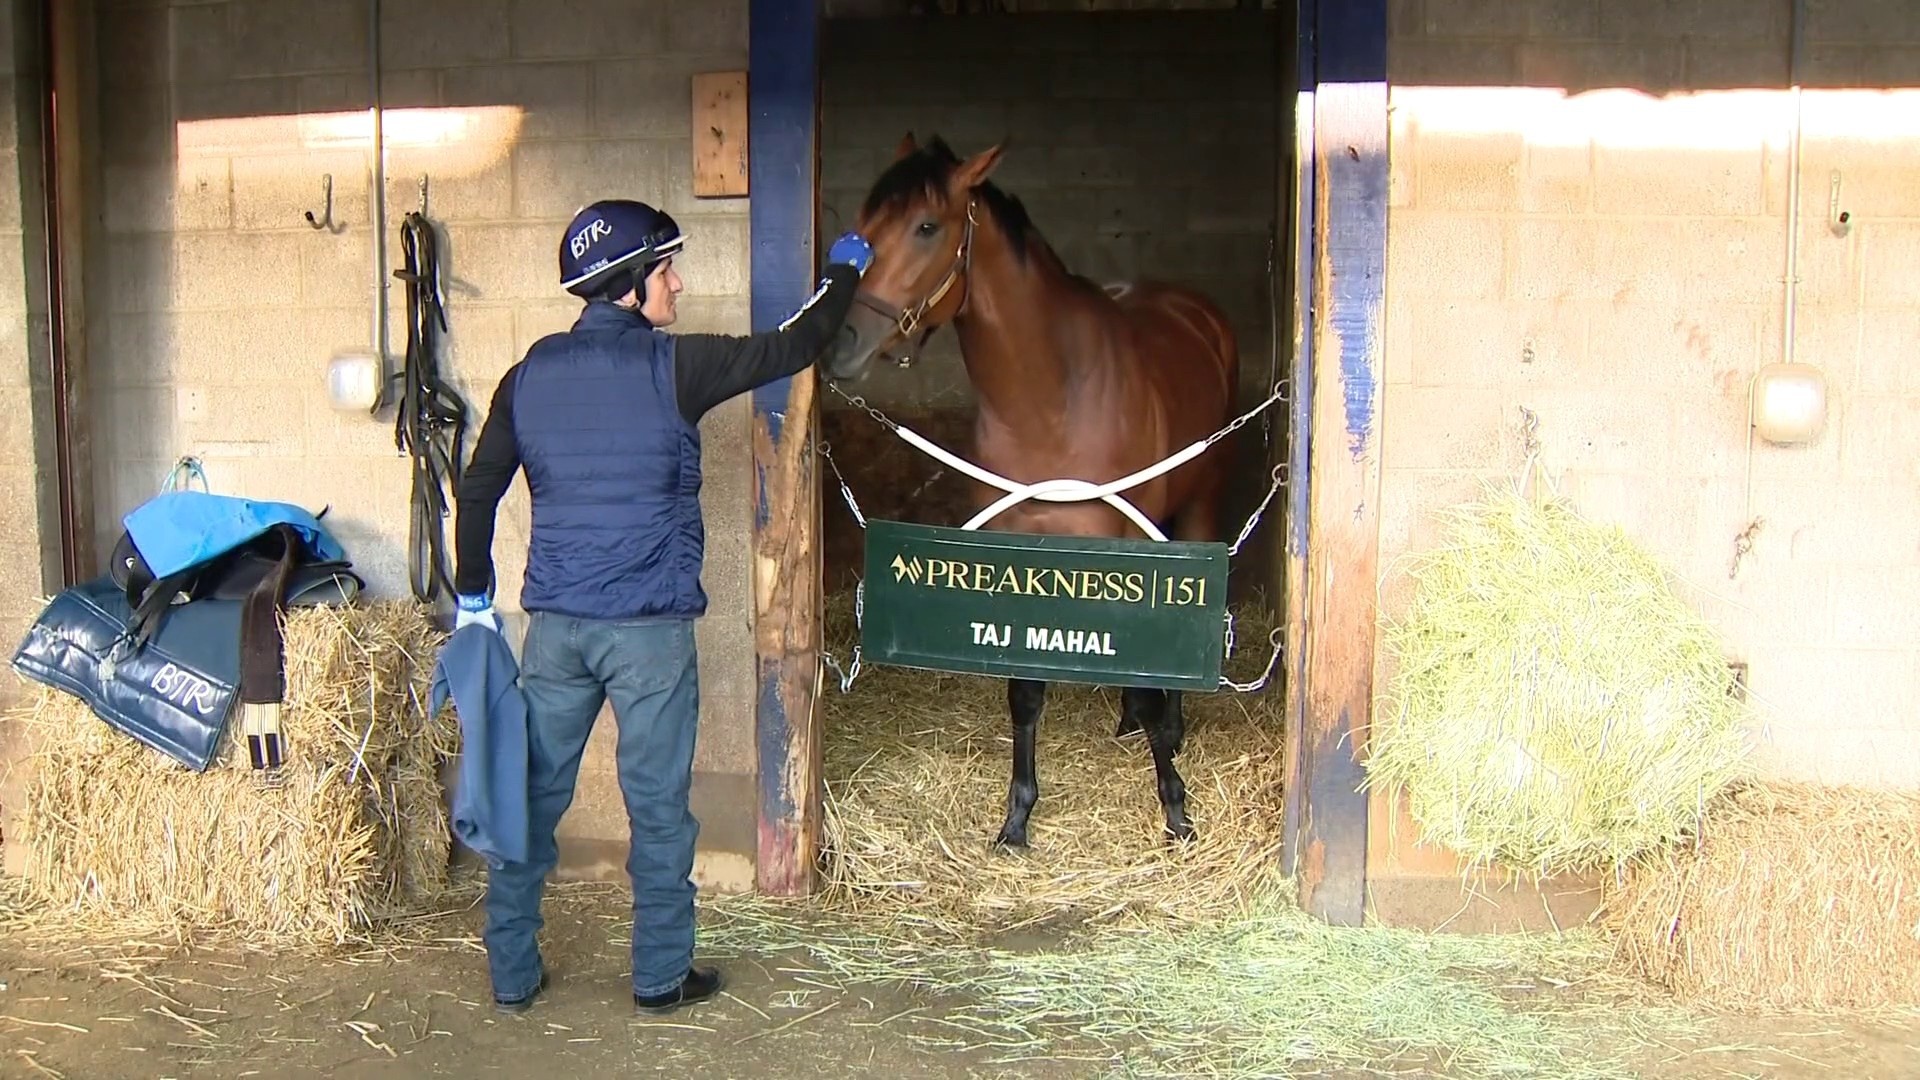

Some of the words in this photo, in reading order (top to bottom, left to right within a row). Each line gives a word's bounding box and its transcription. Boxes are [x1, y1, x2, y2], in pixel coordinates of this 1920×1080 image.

[571, 219, 612, 259] BTR
[924, 558, 1145, 603] PREAKNESS
[1163, 576, 1208, 606] 151
[970, 622, 1011, 647] TAJ
[1026, 627, 1117, 655] MAHAL
[151, 662, 214, 714] BTR
